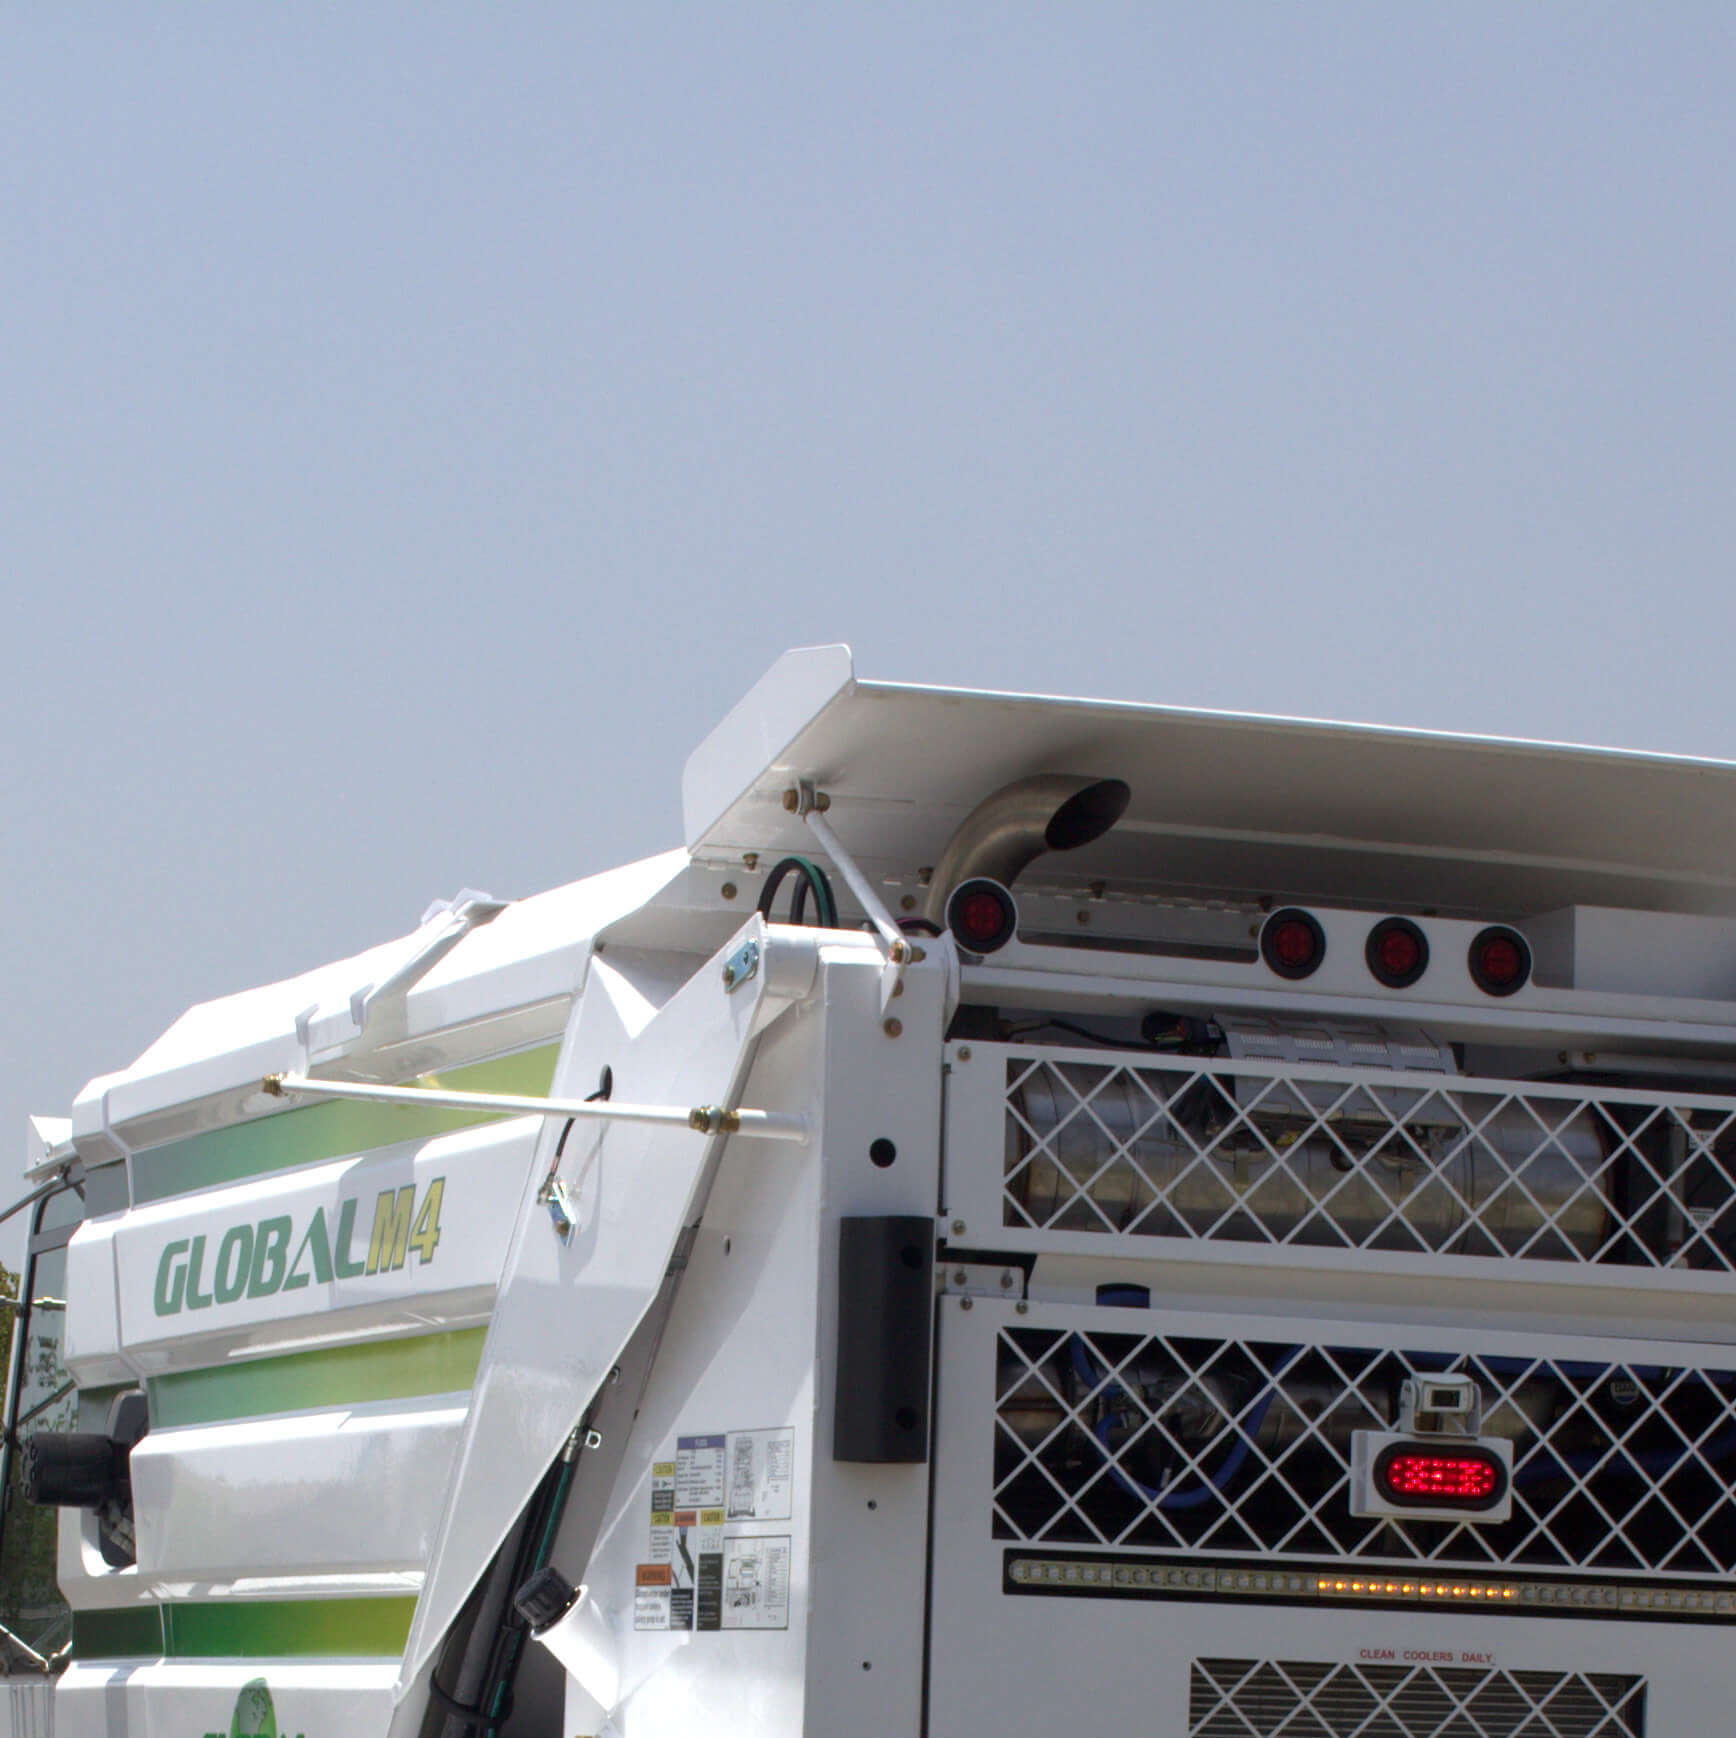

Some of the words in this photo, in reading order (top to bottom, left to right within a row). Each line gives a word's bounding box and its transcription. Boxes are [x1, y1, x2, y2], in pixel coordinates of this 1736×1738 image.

[153, 1198, 367, 1317] GLOBAL
[366, 1176, 447, 1276] M4
[1360, 1649, 1395, 1660] CLEAN
[1403, 1651, 1453, 1662] COOLERS
[1462, 1652, 1492, 1663] DAILY
